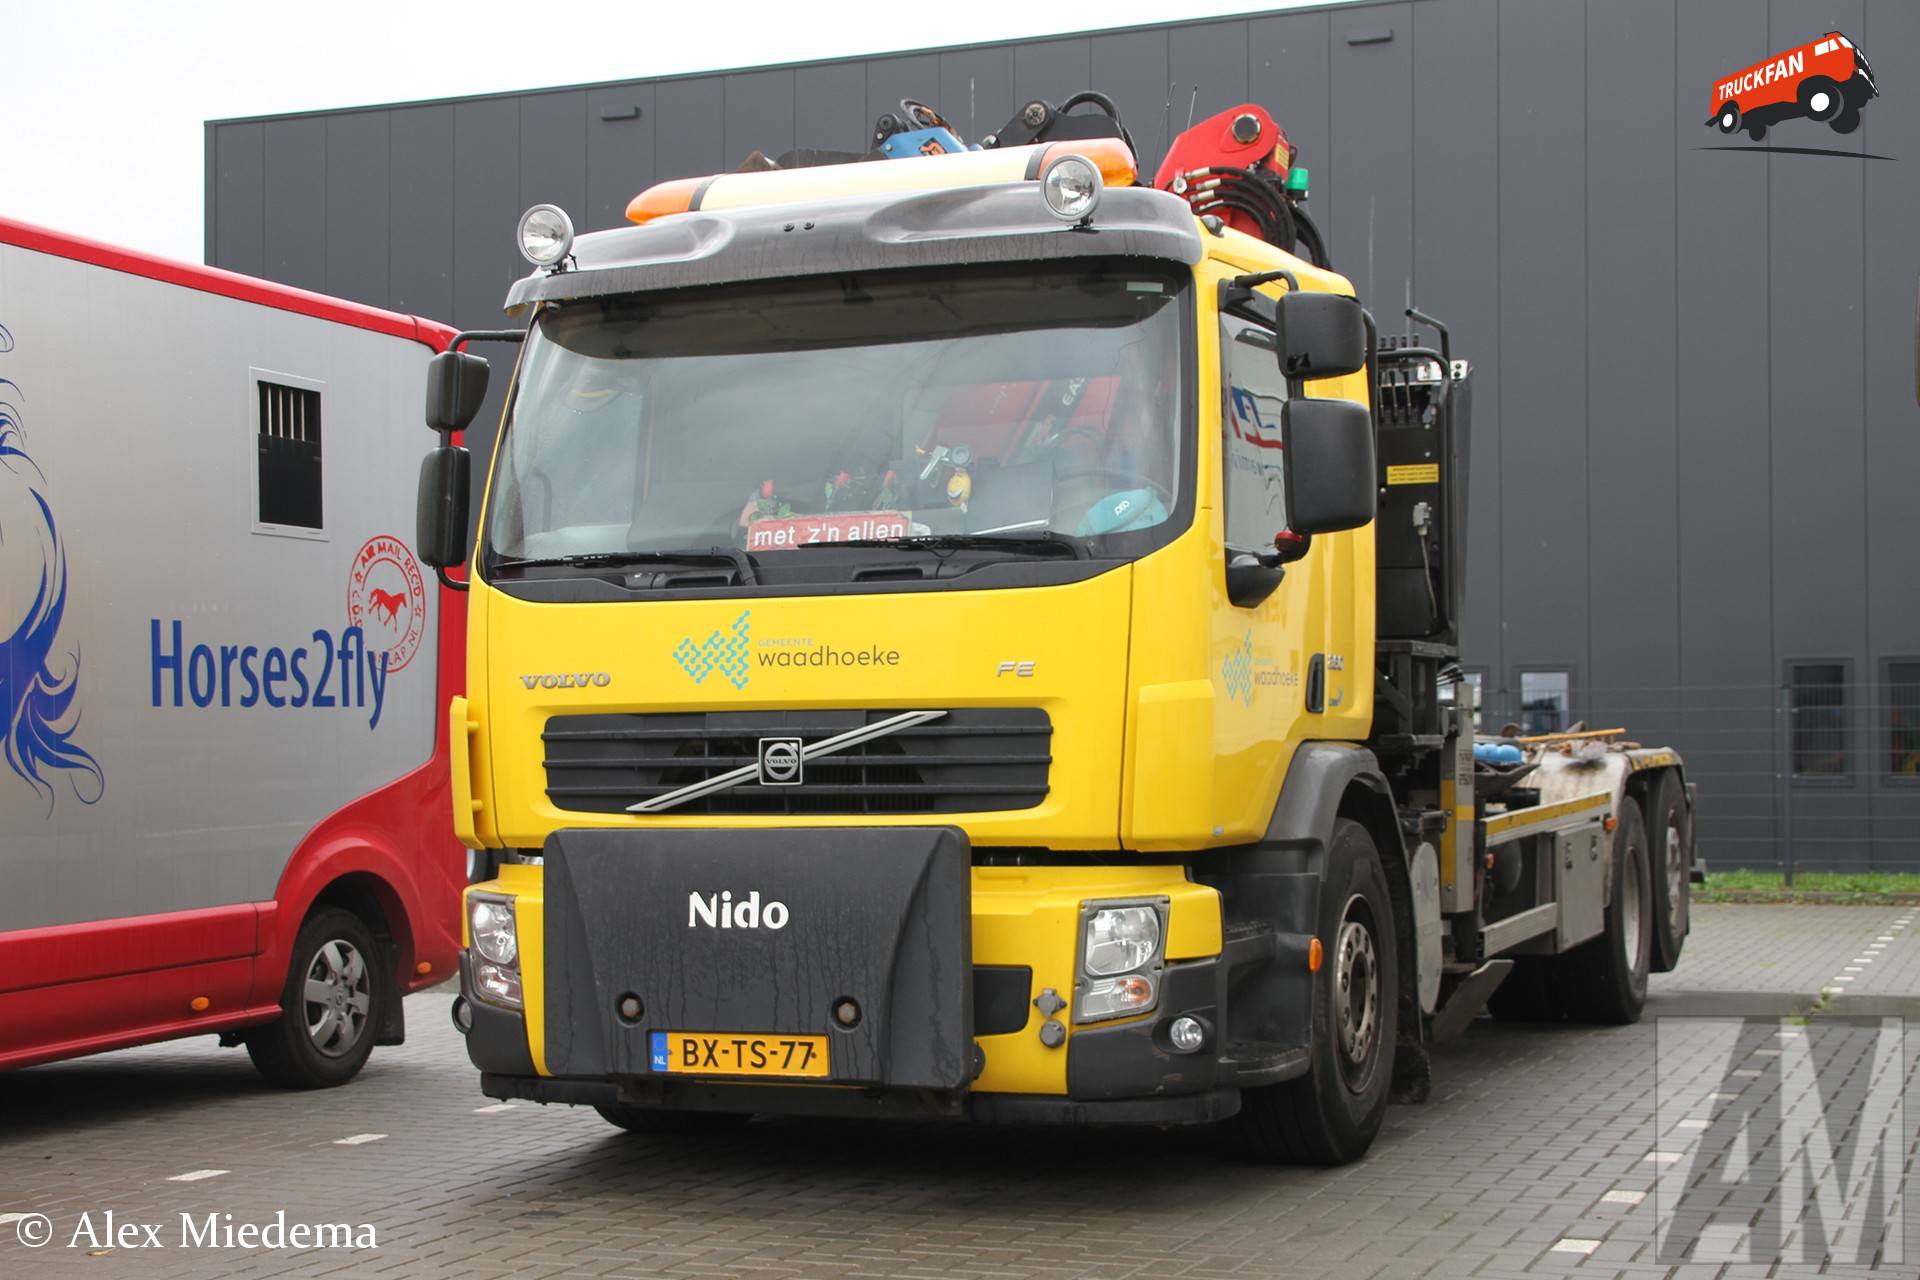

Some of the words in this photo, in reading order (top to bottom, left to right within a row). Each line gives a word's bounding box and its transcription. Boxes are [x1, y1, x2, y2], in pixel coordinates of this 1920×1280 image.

[754, 526, 795, 546] met
[808, 523, 840, 543] z'n
[847, 521, 904, 542] allen
[377, 542, 402, 560] MAIL
[758, 644, 900, 667] waadhoeke
[151, 618, 389, 731] Horses2fly
[519, 671, 611, 690] VOLVO
[996, 660, 1036, 678] FE
[688, 890, 790, 930] Nido
[654, 1055, 667, 1065] NL
[682, 1039, 815, 1070] BX-TS-77
